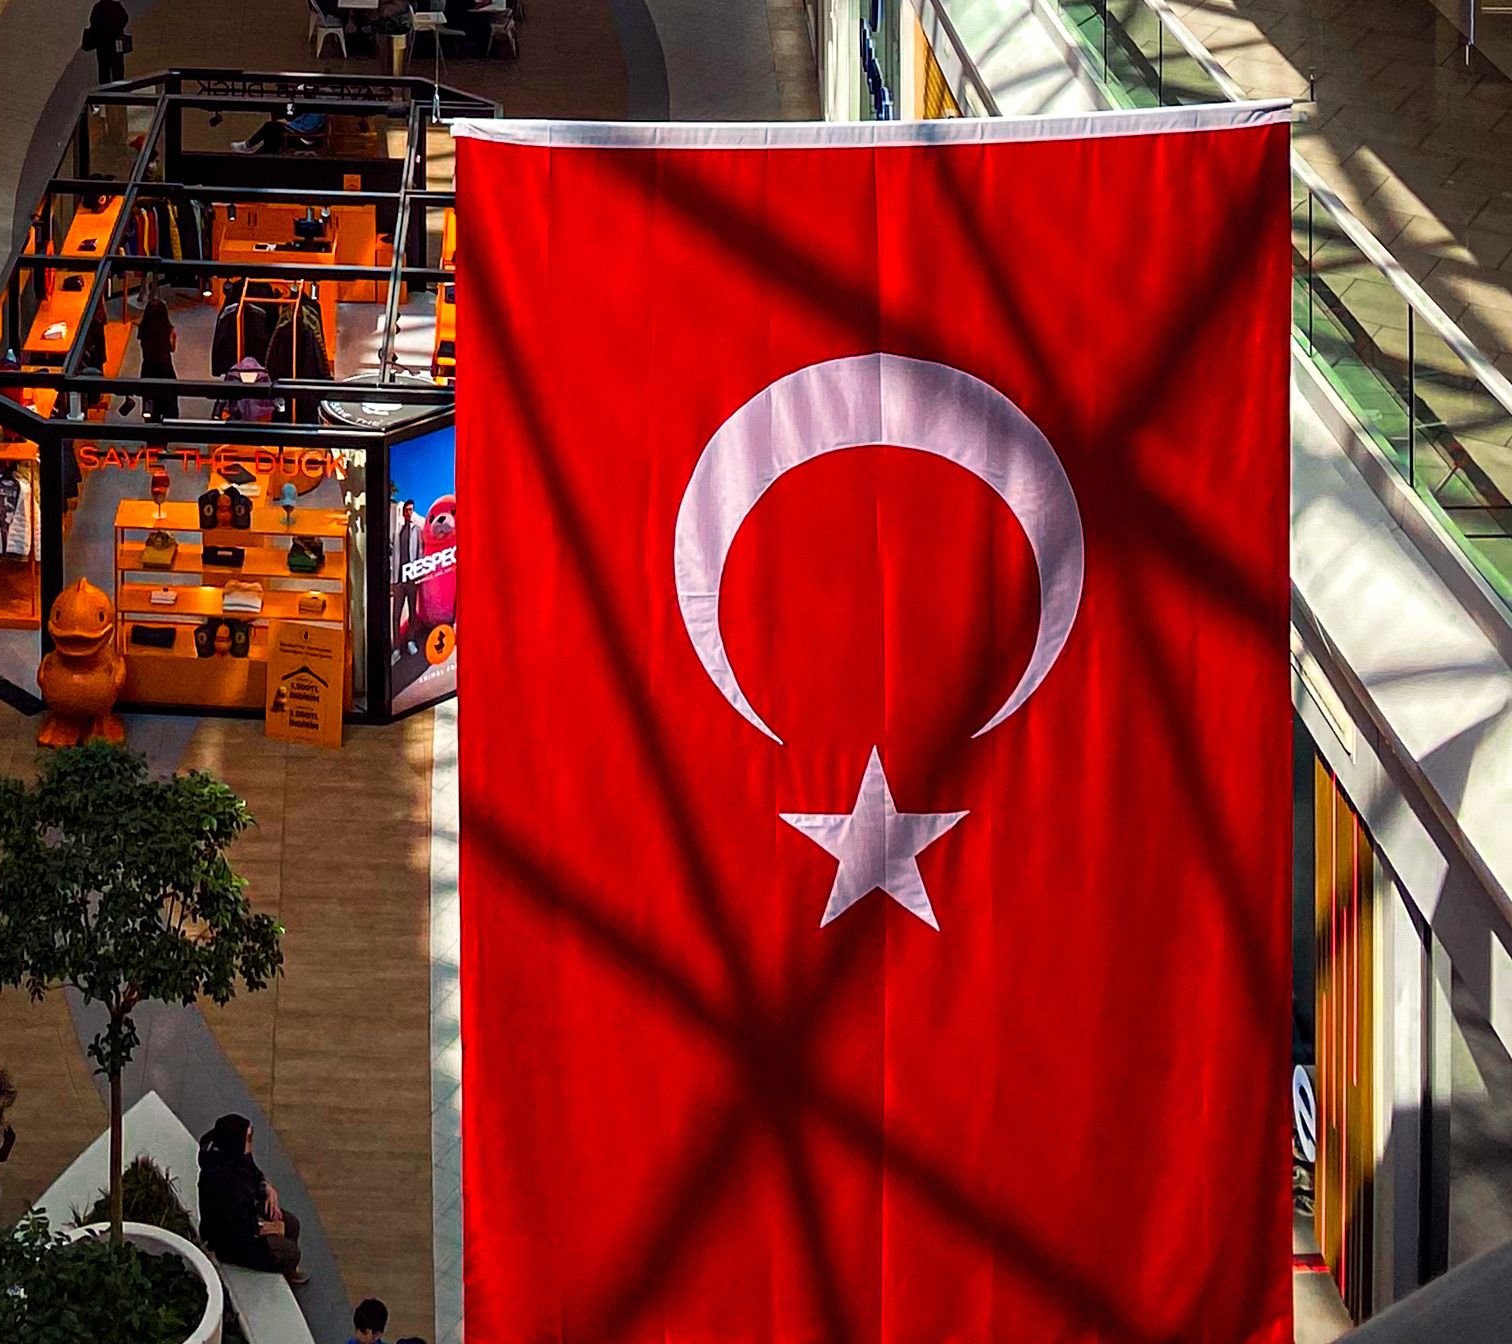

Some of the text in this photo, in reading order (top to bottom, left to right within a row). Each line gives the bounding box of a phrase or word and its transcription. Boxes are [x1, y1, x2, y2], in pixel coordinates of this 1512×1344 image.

[79, 444, 348, 481] SAVE THE DUCK
